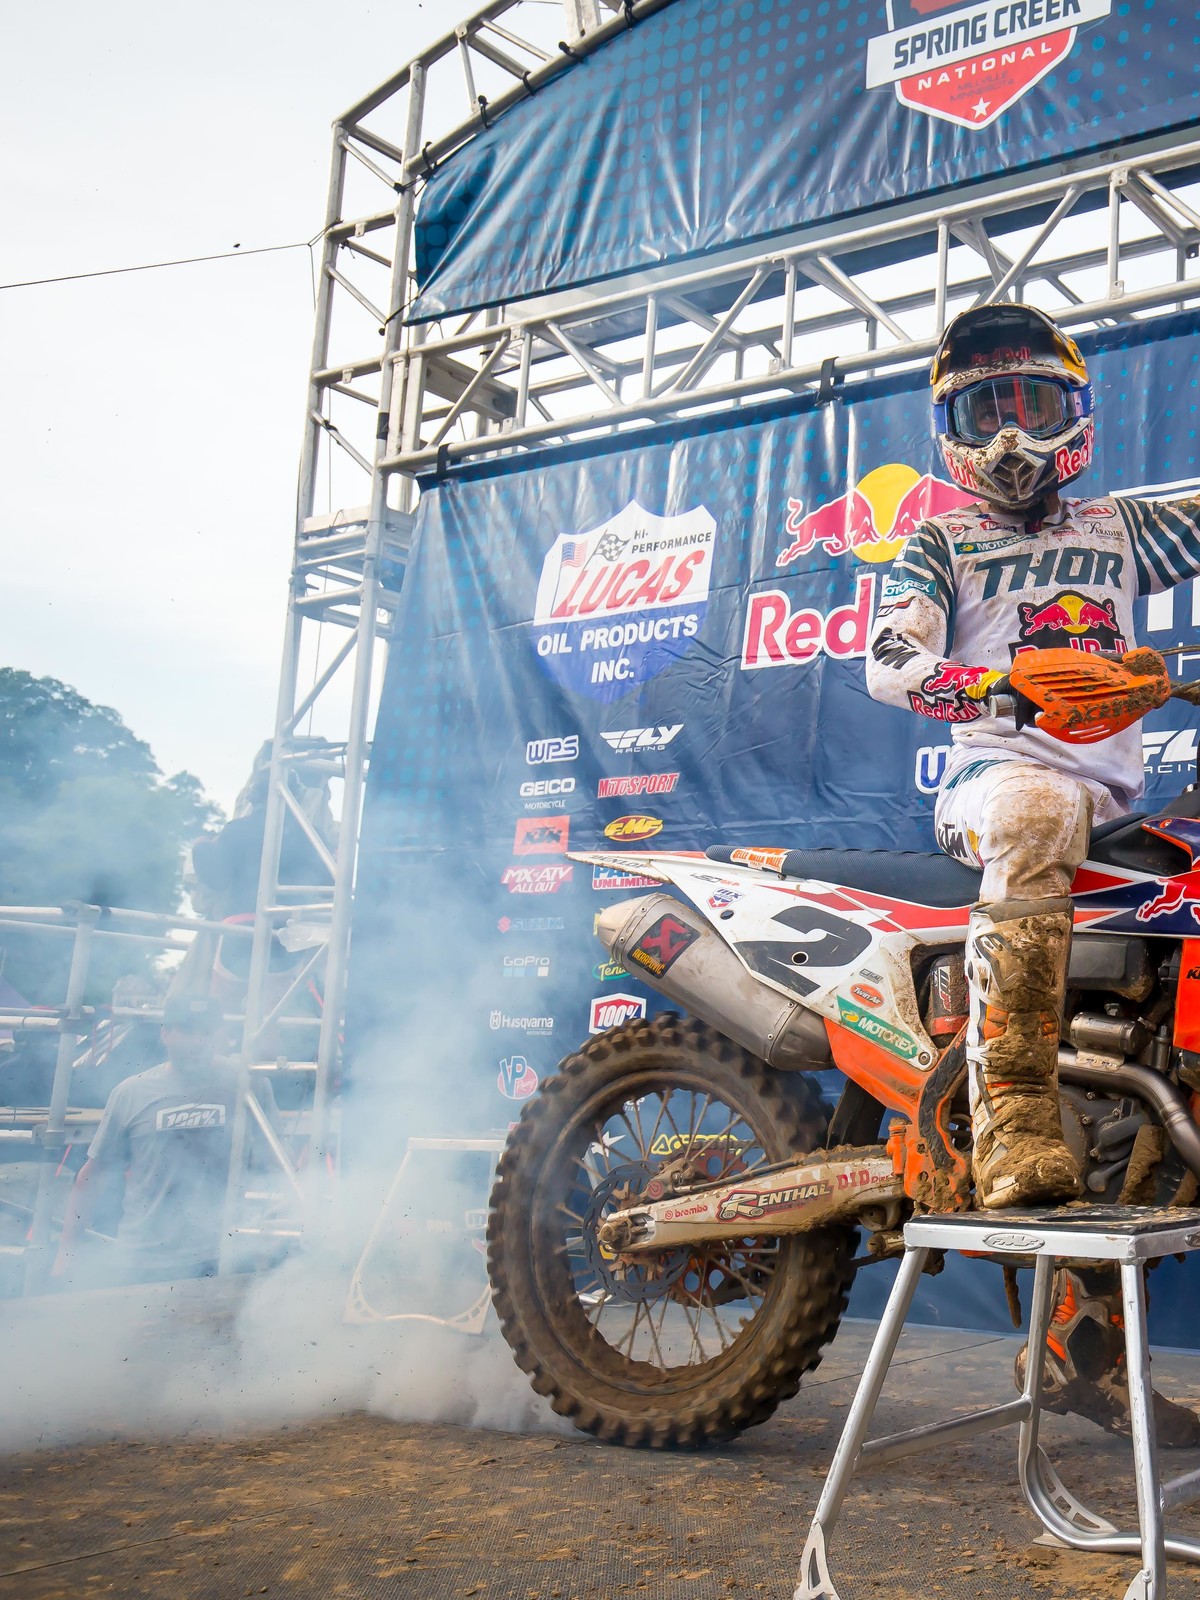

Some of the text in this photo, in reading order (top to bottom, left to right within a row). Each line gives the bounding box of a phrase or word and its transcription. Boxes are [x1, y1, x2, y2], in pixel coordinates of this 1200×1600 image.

[893, 0, 1081, 70] SPRING CREEK
[917, 42, 1052, 91] NATIONAL
[1055, 426, 1090, 482] Red
[631, 532, 712, 554] PERFORMANCE
[550, 549, 706, 619] LUCAS
[974, 547, 1124, 601] THOR
[885, 580, 931, 597] OTOREX
[741, 574, 876, 669] Red
[537, 615, 699, 657] OIL PRODUCTS
[590, 660, 635, 684] INC.
[912, 694, 944, 721] Red
[600, 724, 684, 750] FLY
[614, 744, 667, 754] RACING
[526, 735, 579, 765] WPS
[519, 778, 576, 797] GEICO
[524, 799, 566, 810] MOTORCYCLE
[604, 817, 663, 837] FMF
[503, 867, 534, 884] MX
[537, 867, 573, 882] ATV
[509, 881, 559, 894] ALL OUT
[592, 876, 662, 888] UNLIMITE
[503, 956, 550, 967] GoPro
[733, 904, 873, 998] 2
[853, 986, 871, 1000] Twin
[598, 1004, 642, 1027] 100%
[857, 1017, 914, 1055] MOTOREX
[499, 1056, 528, 1098] VP
[674, 1205, 708, 1219] brembo
[719, 1184, 831, 1220] RENTHAL
